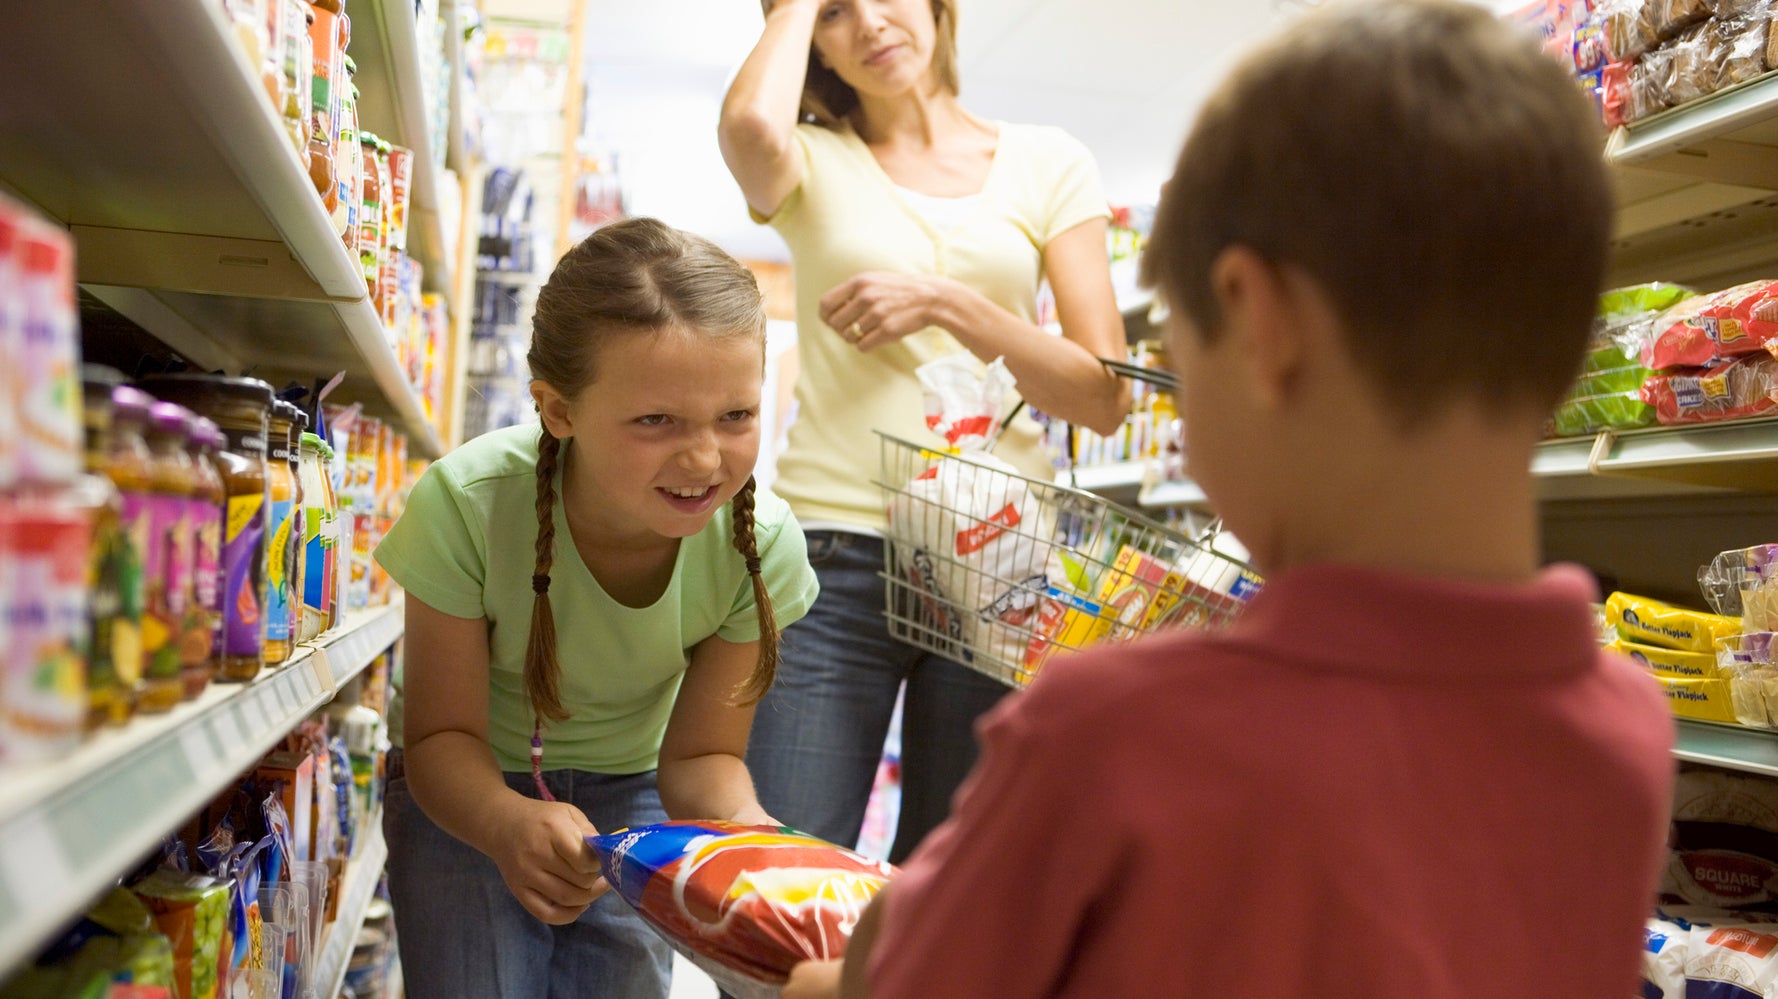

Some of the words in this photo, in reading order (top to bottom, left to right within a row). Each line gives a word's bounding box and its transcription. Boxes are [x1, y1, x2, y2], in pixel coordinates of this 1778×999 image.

[1662, 627, 1693, 640] Flapjack
[1674, 664, 1704, 676] Flapjack
[1677, 690, 1709, 702] Flapjack
[1695, 867, 1760, 888] SQUARE
[1714, 883, 1742, 893] WHITE
